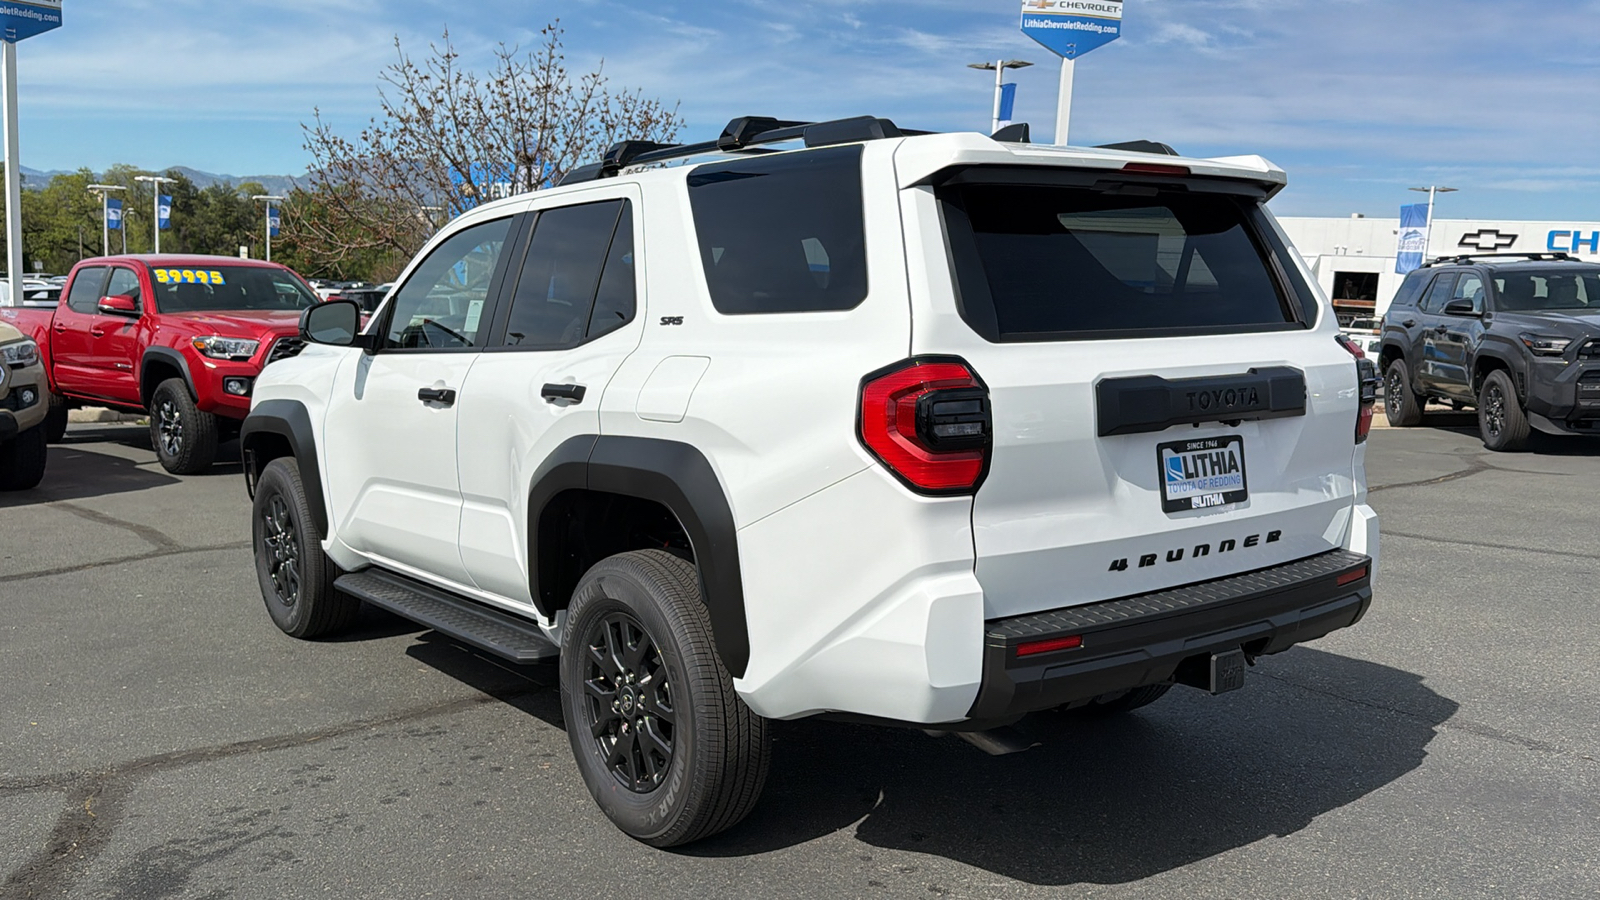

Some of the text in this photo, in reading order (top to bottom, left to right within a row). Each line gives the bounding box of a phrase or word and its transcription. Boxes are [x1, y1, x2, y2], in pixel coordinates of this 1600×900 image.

[1060, 2, 1119, 13] CHEVROLET
[1024, 19, 1118, 34] LithiaChevroletRedding.com
[1547, 230, 1600, 253] CH
[154, 269, 223, 284] 39995
[659, 316, 684, 326] SR5
[1186, 388, 1259, 410] TOYOTA
[1187, 440, 1218, 450] SINCE 1946
[1182, 450, 1240, 480] LITHIA
[1168, 475, 1241, 494] TOYOTA OF REDDING
[1199, 492, 1225, 507] LITHIA
[1108, 530, 1282, 571] 4RUNNER
[562, 584, 596, 648] YOKOHAMA
